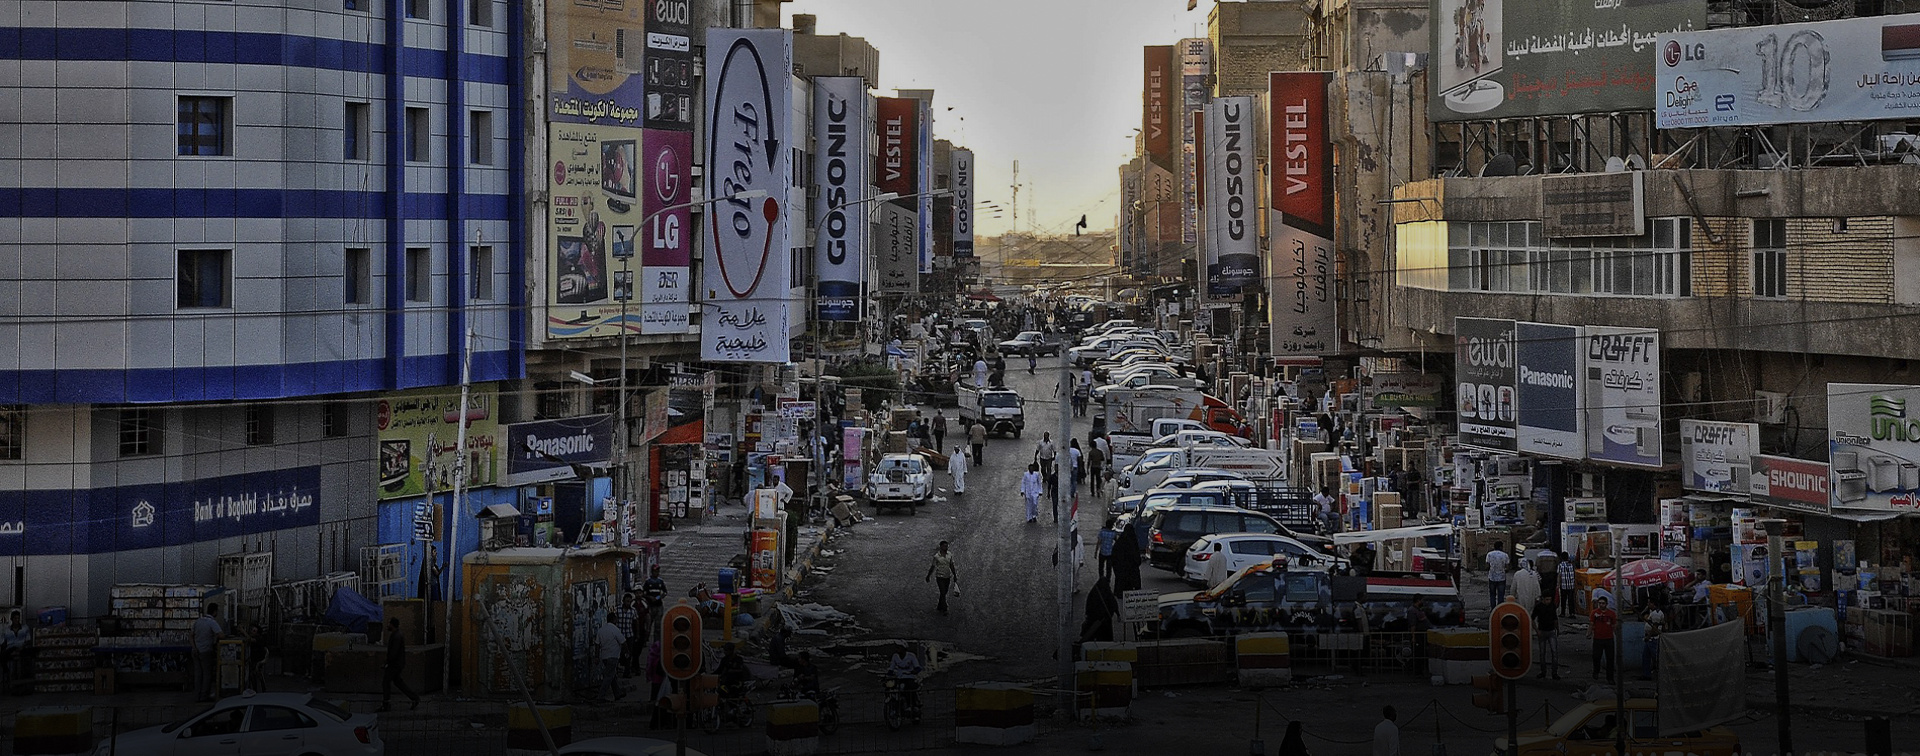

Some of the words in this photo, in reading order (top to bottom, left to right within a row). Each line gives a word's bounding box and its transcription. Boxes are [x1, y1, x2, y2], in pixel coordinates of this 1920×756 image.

[1685, 43, 1705, 61] LG
[1857, 73, 1880, 88] البال
[582, 98, 609, 123] الكويت
[1149, 66, 1161, 140] VESTEL
[885, 115, 903, 182] VESTEL
[1286, 98, 1308, 196] VESTEL
[827, 99, 847, 266] GOSONIC
[1224, 103, 1245, 241] GOSONIC
[653, 213, 679, 250] LG
[1221, 265, 1254, 277] جوسونك
[1293, 238, 1309, 314] تكنولوجيا
[1314, 246, 1329, 302] ترافقك
[718, 306, 767, 330] علامة
[715, 332, 767, 359] خليجية
[1458, 330, 1512, 368] newal
[1520, 365, 1574, 389] Panasonic
[526, 428, 594, 459] Panasonic
[1770, 469, 1827, 493] SHOWNIC
[195, 498, 213, 521] Bank
[216, 496, 224, 518] of
[228, 492, 257, 521] Baghdad
[261, 488, 287, 516] بغداد
[290, 486, 312, 512] مصرف
